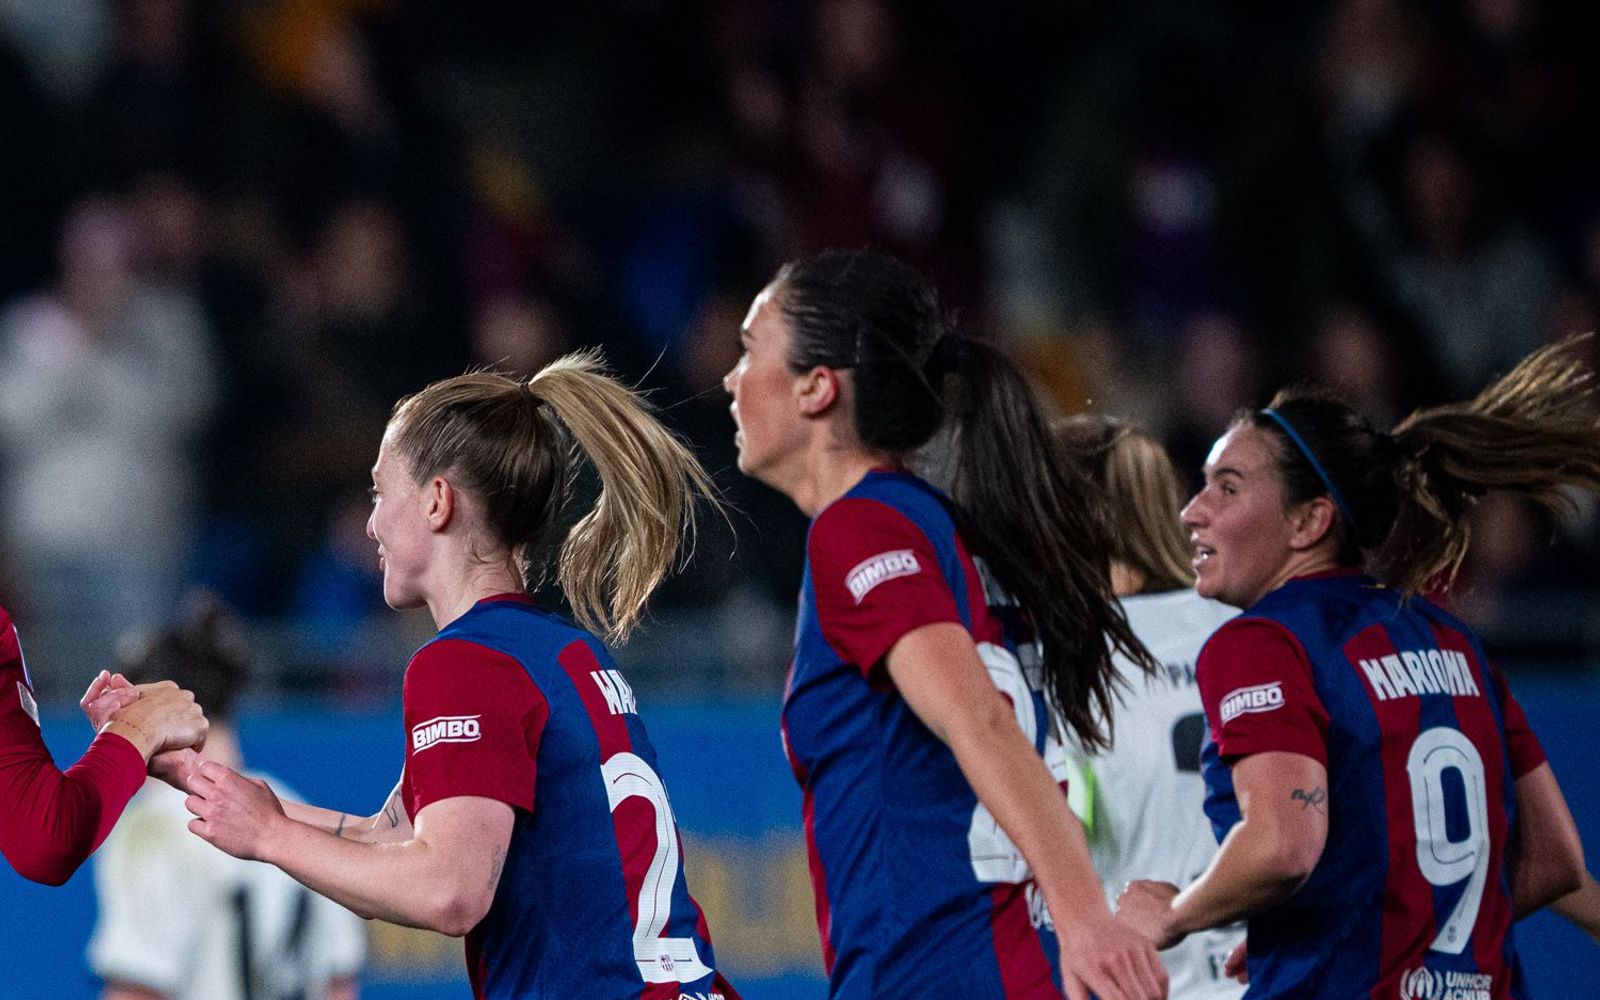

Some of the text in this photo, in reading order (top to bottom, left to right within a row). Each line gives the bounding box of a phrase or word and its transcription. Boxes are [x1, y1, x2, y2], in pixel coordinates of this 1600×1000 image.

[847, 551, 920, 602] BIMBO
[1359, 648, 1480, 701] MARIONA
[1220, 686, 1284, 721] BIMBO
[412, 719, 480, 750] BIMBO
[1406, 726, 1491, 955] 9
[1444, 970, 1493, 990] UNHCR
